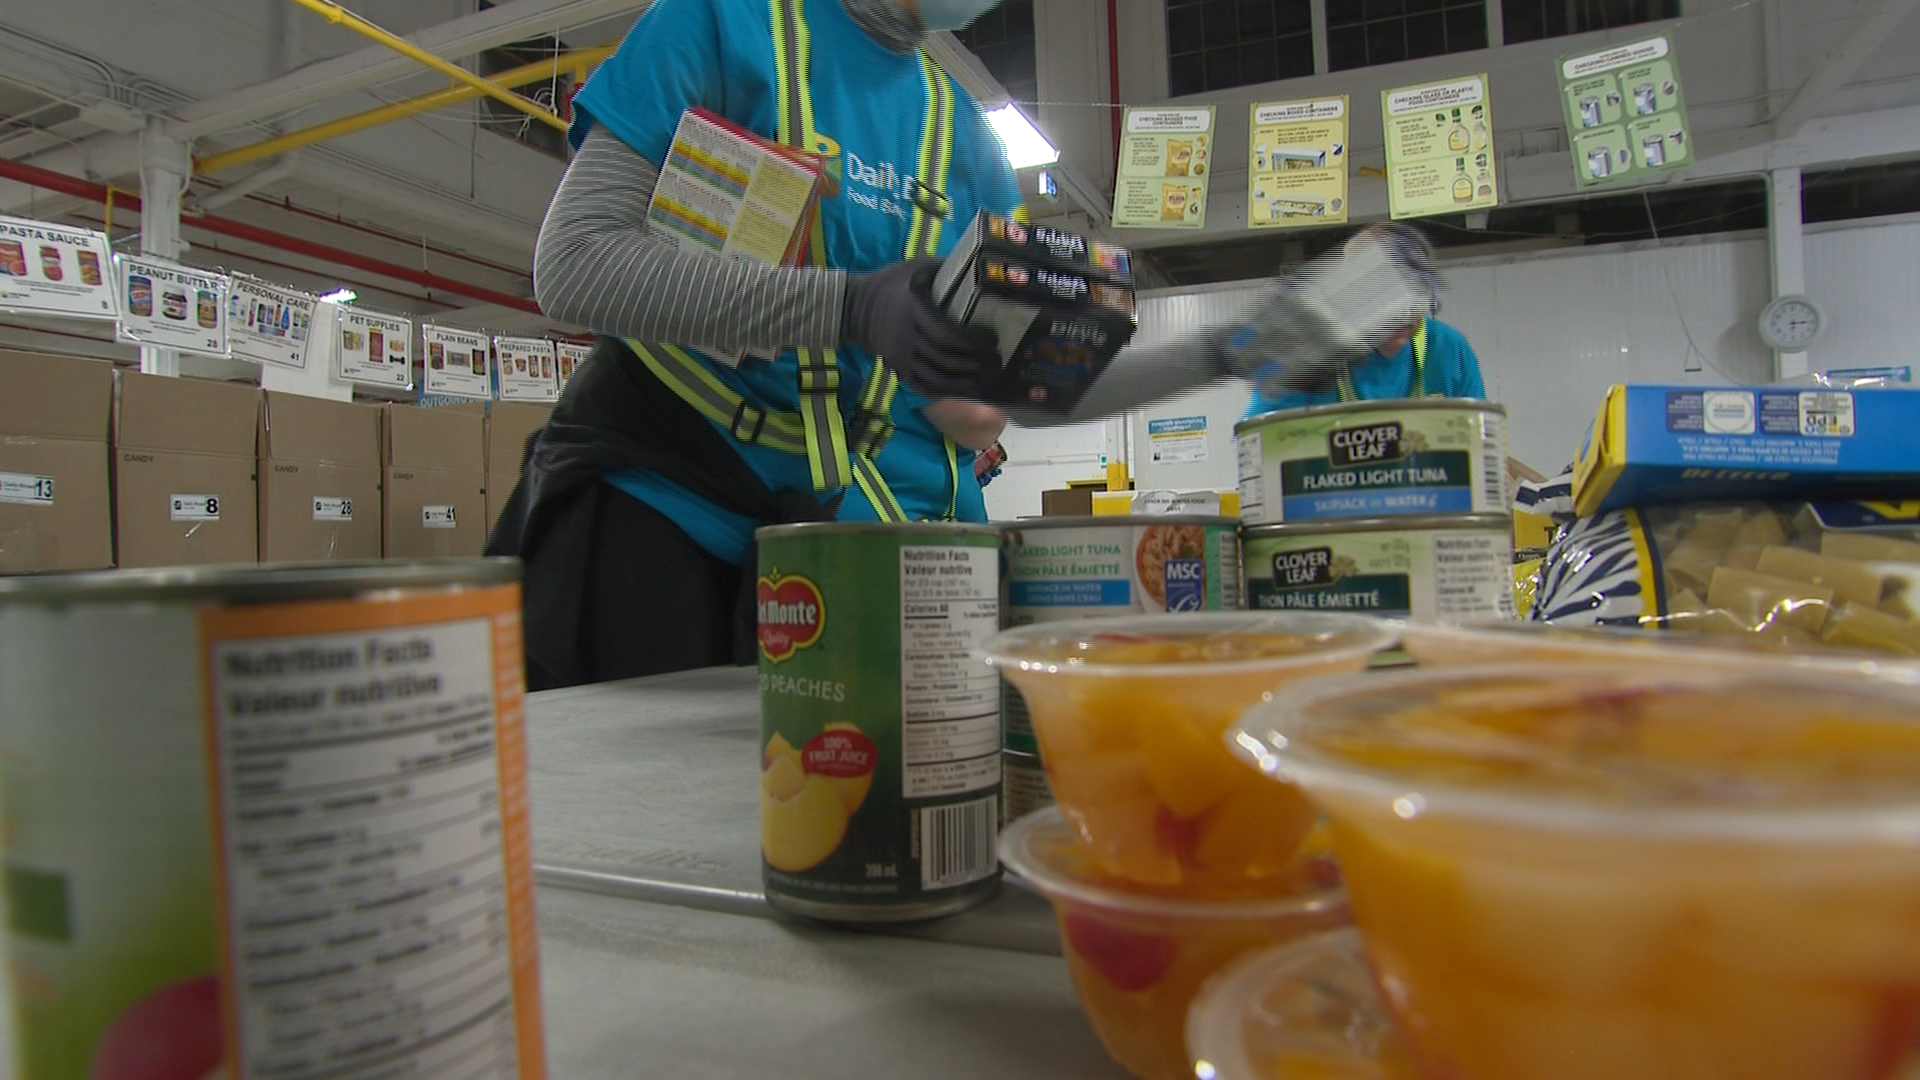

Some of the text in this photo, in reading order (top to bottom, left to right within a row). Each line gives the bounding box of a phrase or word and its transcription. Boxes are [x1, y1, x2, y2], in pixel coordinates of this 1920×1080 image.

[847, 151, 901, 200] Daily
[0, 225, 91, 247] PASTA SAUCE
[129, 264, 218, 290] PEANUT BUTTER
[238, 281, 311, 311] PERSONAL CARE
[350, 315, 400, 332] PET SUPPLIES
[437, 333, 479, 347] PLAIN BEANS
[501, 343, 551, 353] PREPARED PASTA
[291, 352, 300, 361] 41
[1333, 426, 1398, 448] CLOVER
[124, 454, 154, 463] CANDY
[1349, 444, 1387, 461] LEAF
[275, 464, 299, 473] CANDY
[394, 472, 414, 480] CANDY
[1303, 467, 1448, 489] FLAKED LIGHT TUNA
[36, 479, 53, 497] 13
[206, 498, 218, 514] 8
[341, 501, 352, 515] 28
[1315, 497, 1367, 512] SKIPJACK
[1385, 495, 1424, 508] WATER
[446, 508, 456, 520] 41
[904, 550, 969, 561] Nutrition Facts
[1051, 545, 1084, 557] LIGHT
[1087, 544, 1121, 554] TUNA
[904, 564, 973, 575] Valeur nutritive
[1042, 563, 1067, 576] PÂLE
[1070, 561, 1120, 575] ÉMIETTÉ
[1275, 551, 1328, 571] CLOVER
[1167, 562, 1200, 579] MSC
[1286, 567, 1319, 584] LEAF
[1287, 591, 1315, 608] PÂLE
[1318, 589, 1380, 608] ÉMIETTÉ
[768, 600, 817, 625] Monte
[904, 604, 938, 613] Calories
[226, 637, 434, 676] Nutrition Facts
[334, 671, 442, 706] nutritive
[771, 674, 846, 702] PEACHES
[824, 737, 853, 750] 100%
[809, 750, 870, 765] FRUIT JUICE
